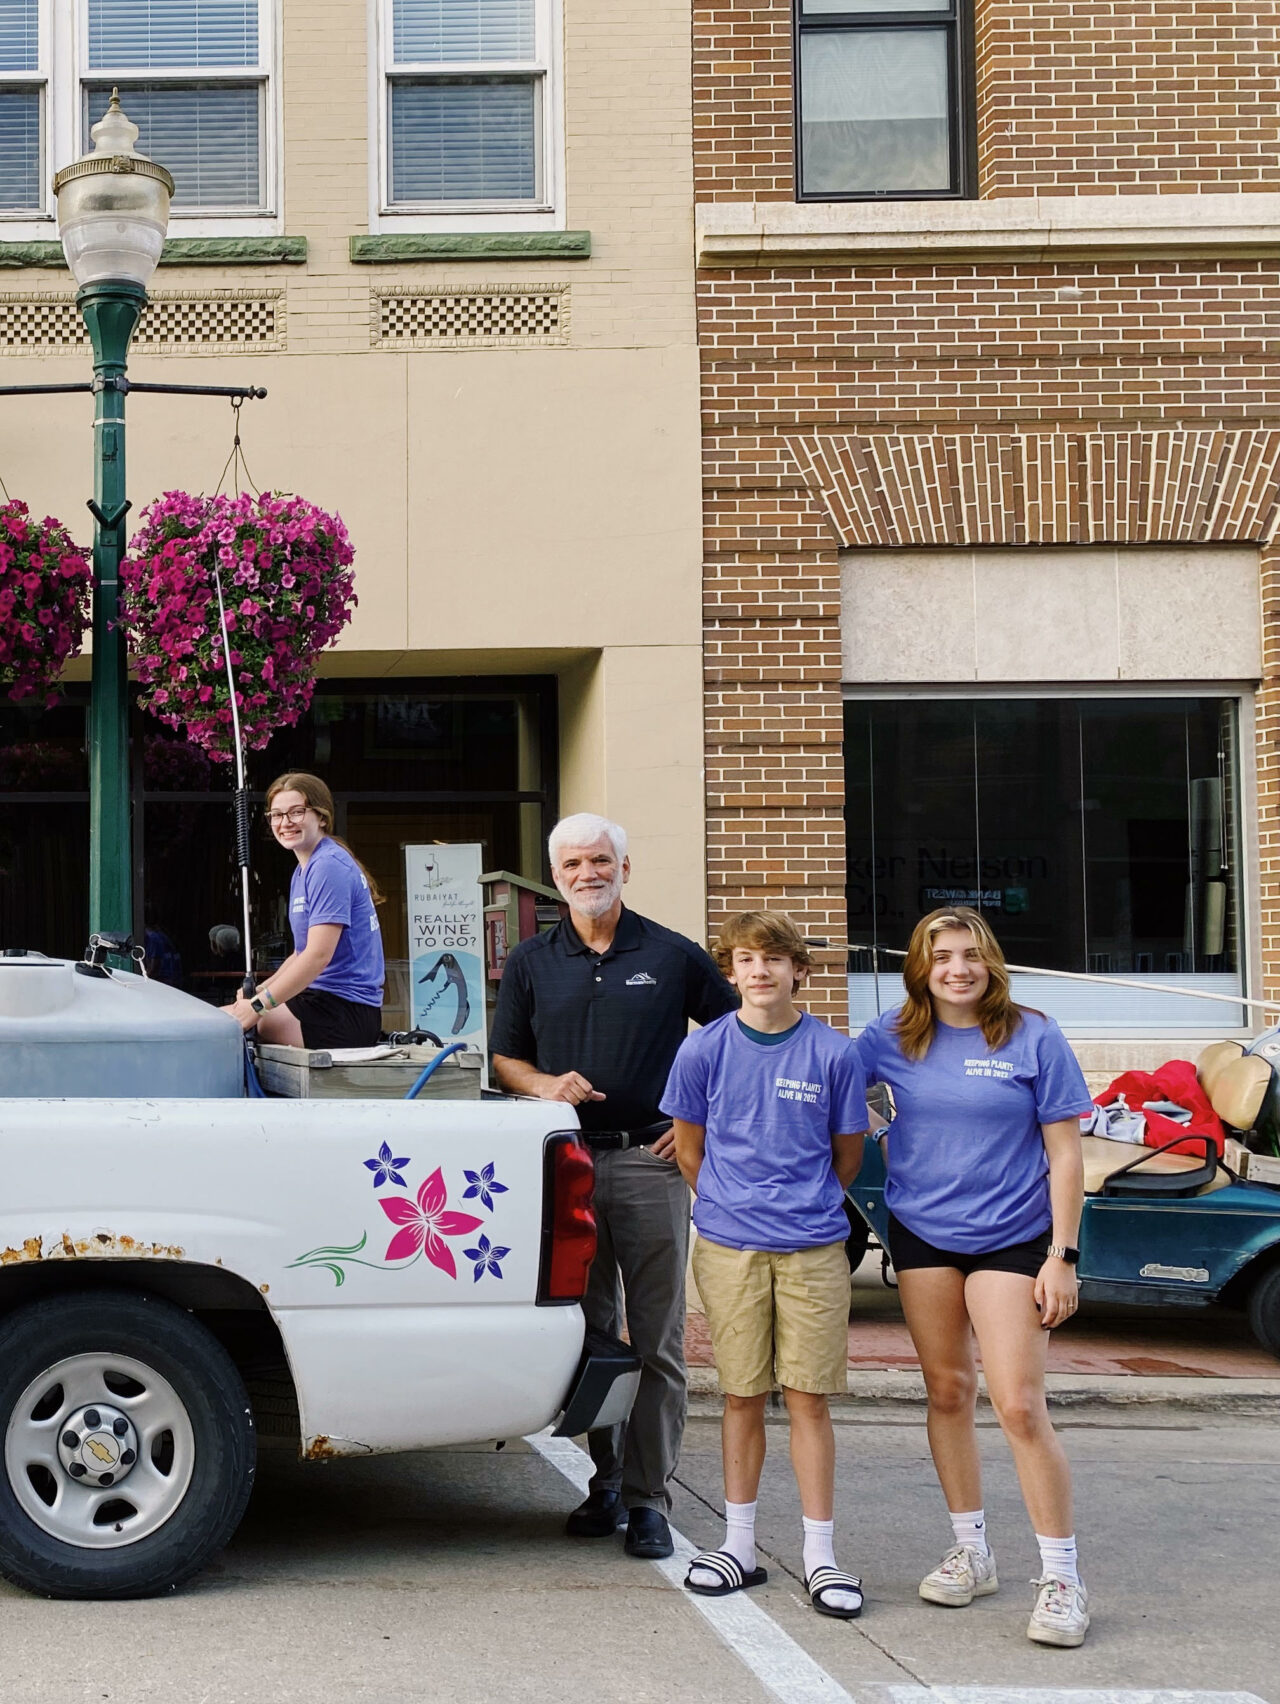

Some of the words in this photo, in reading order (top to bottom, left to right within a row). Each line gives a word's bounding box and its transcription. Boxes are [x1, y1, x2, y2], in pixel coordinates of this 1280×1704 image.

[917, 848, 1048, 880] Nelson
[414, 893, 458, 901] RUBAIYAT
[414, 913, 477, 924] REALLY?
[418, 924, 471, 935] WINE
[414, 937, 437, 947] TO
[443, 936, 477, 947] GO?
[964, 1058, 990, 1068] KEEPING
[991, 1059, 1014, 1071] PLANTS
[965, 1067, 983, 1076] ALIVE
[983, 1068, 992, 1077] IN
[992, 1069, 1009, 1079] 2022
[775, 1077, 801, 1090] KEEPING
[801, 1081, 822, 1093] PLANTS
[777, 1088, 794, 1100] ALIVE
[794, 1091, 803, 1101] IN
[803, 1092, 817, 1103] 2022
